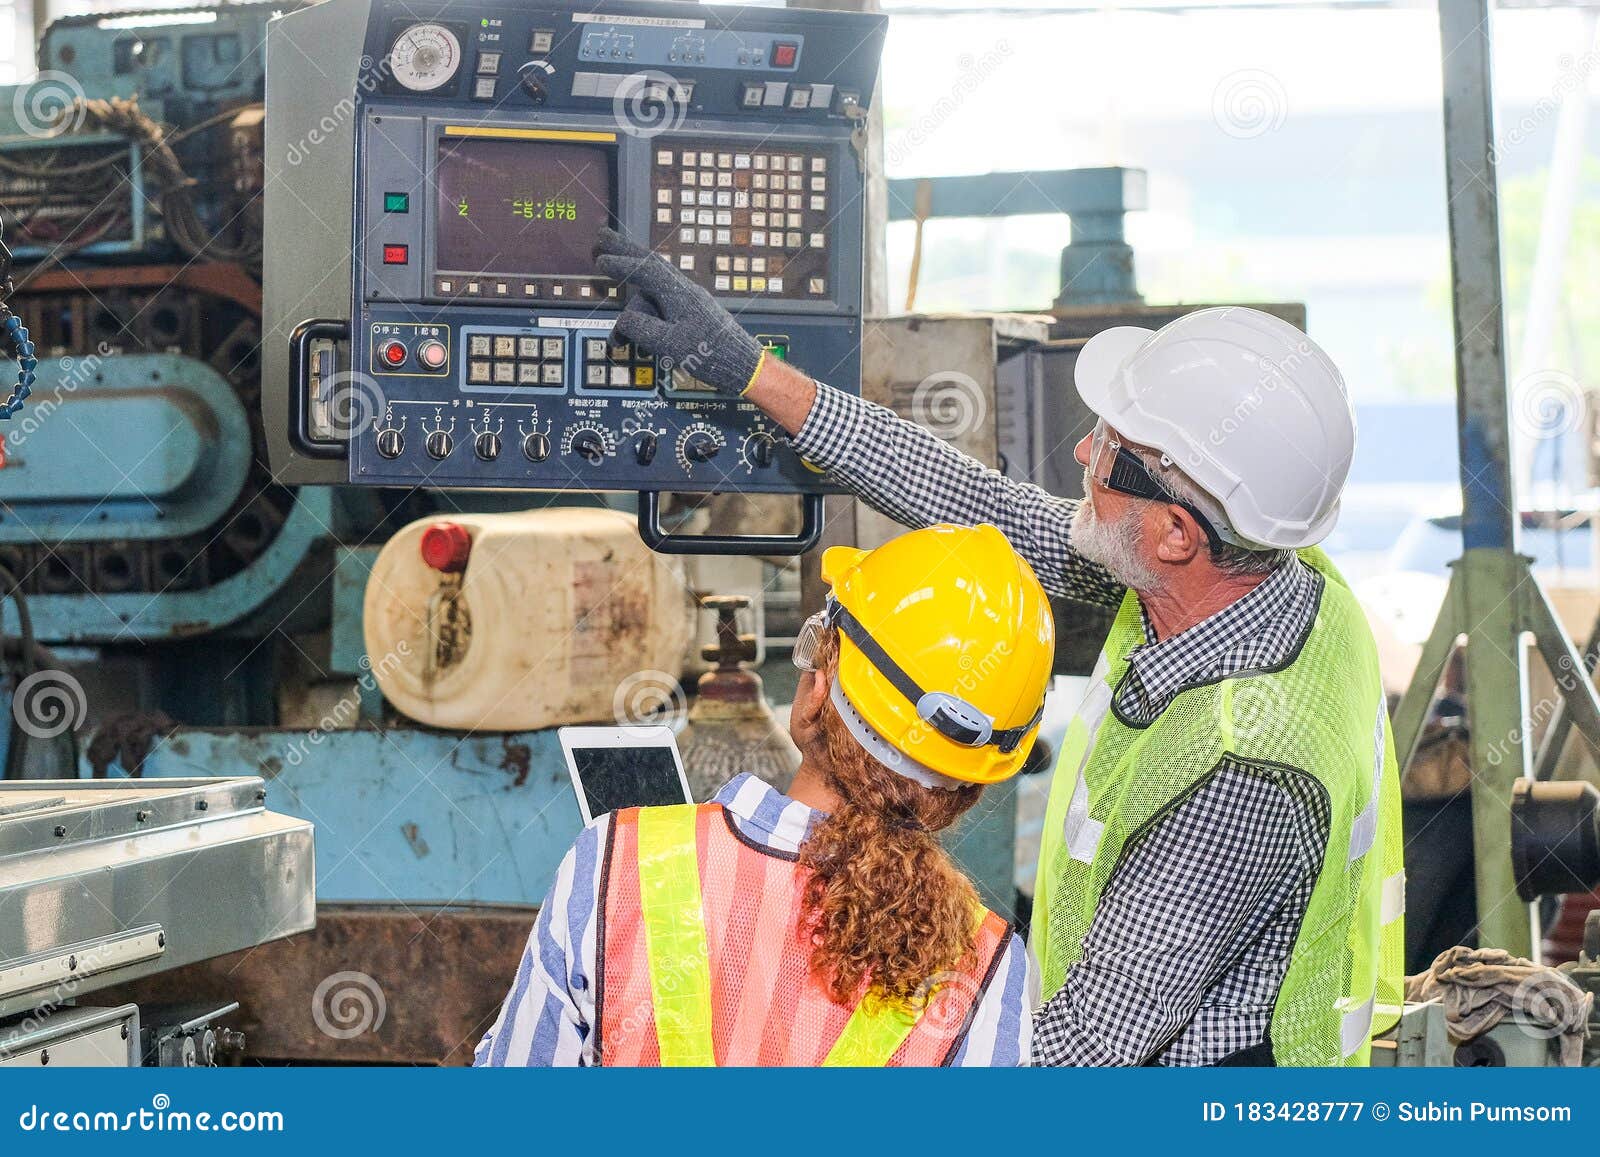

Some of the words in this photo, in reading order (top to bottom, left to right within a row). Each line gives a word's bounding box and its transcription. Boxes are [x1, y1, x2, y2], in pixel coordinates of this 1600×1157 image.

[513, 207, 577, 220] -5.070
[382, 326, 400, 335] 停止
[421, 327, 439, 336] 起動
[452, 400, 474, 408] 手動
